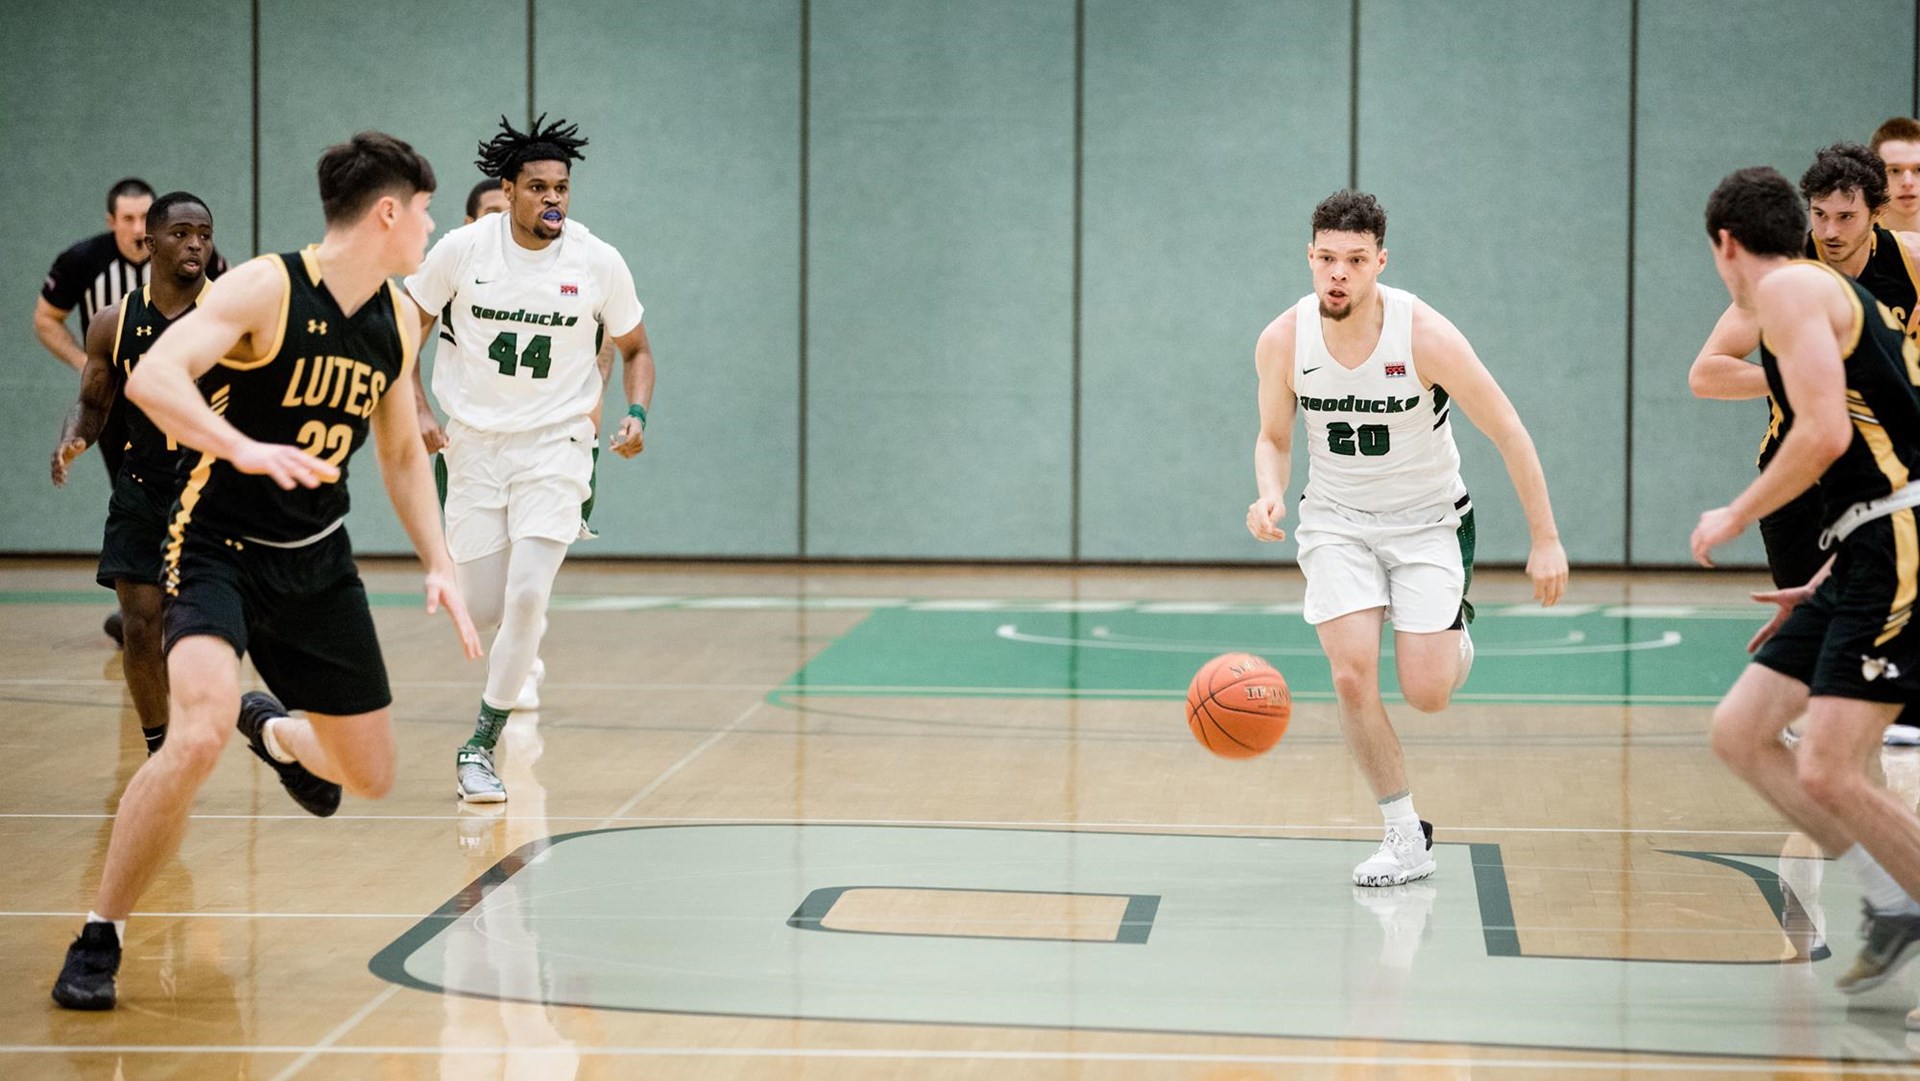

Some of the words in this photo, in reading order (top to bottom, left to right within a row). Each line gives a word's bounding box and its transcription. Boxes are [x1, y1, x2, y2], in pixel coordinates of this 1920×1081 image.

[488, 331, 552, 379] 44
[281, 355, 387, 420] LUTES
[296, 419, 354, 482] 22
[1326, 421, 1391, 456] 20
